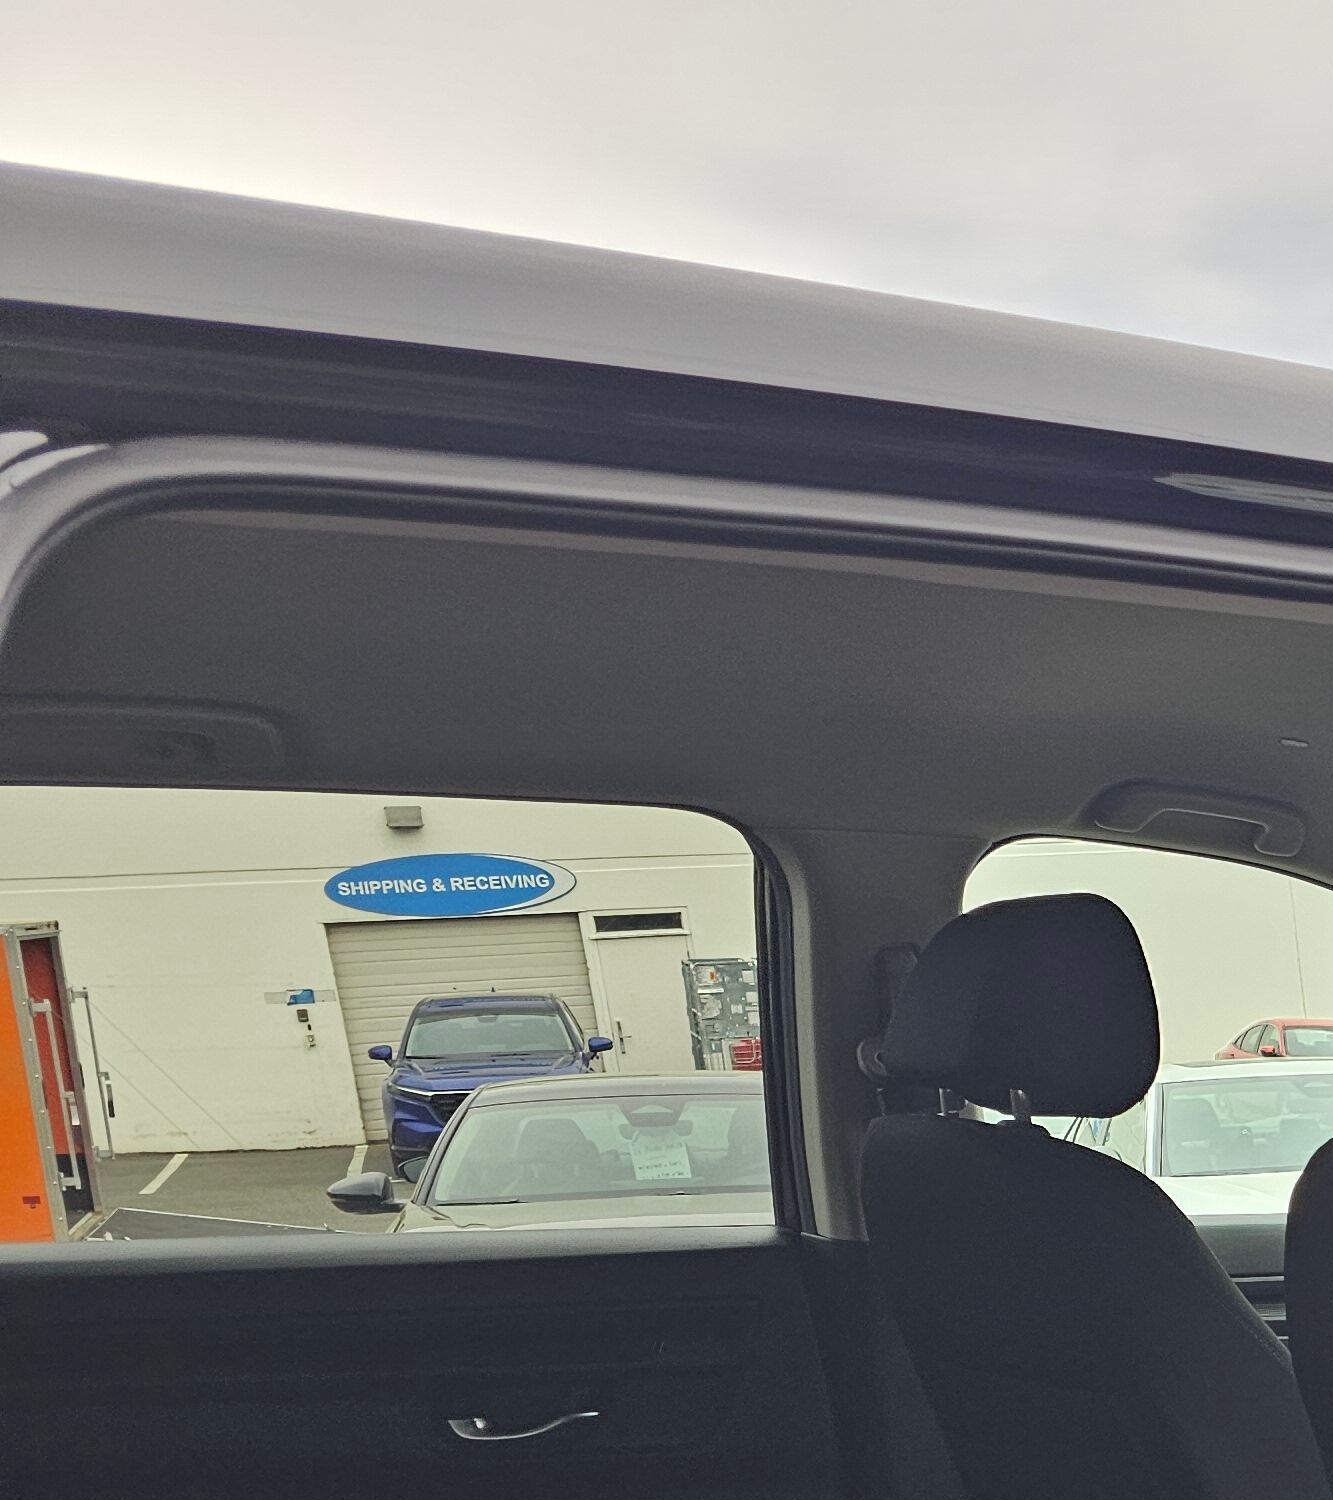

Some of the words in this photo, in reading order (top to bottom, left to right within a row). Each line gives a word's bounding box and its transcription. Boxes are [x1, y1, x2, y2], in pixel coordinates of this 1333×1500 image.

[337, 878, 427, 896] SHIPPING
[432, 877, 446, 892] &
[449, 873, 550, 892] RECEIVING
